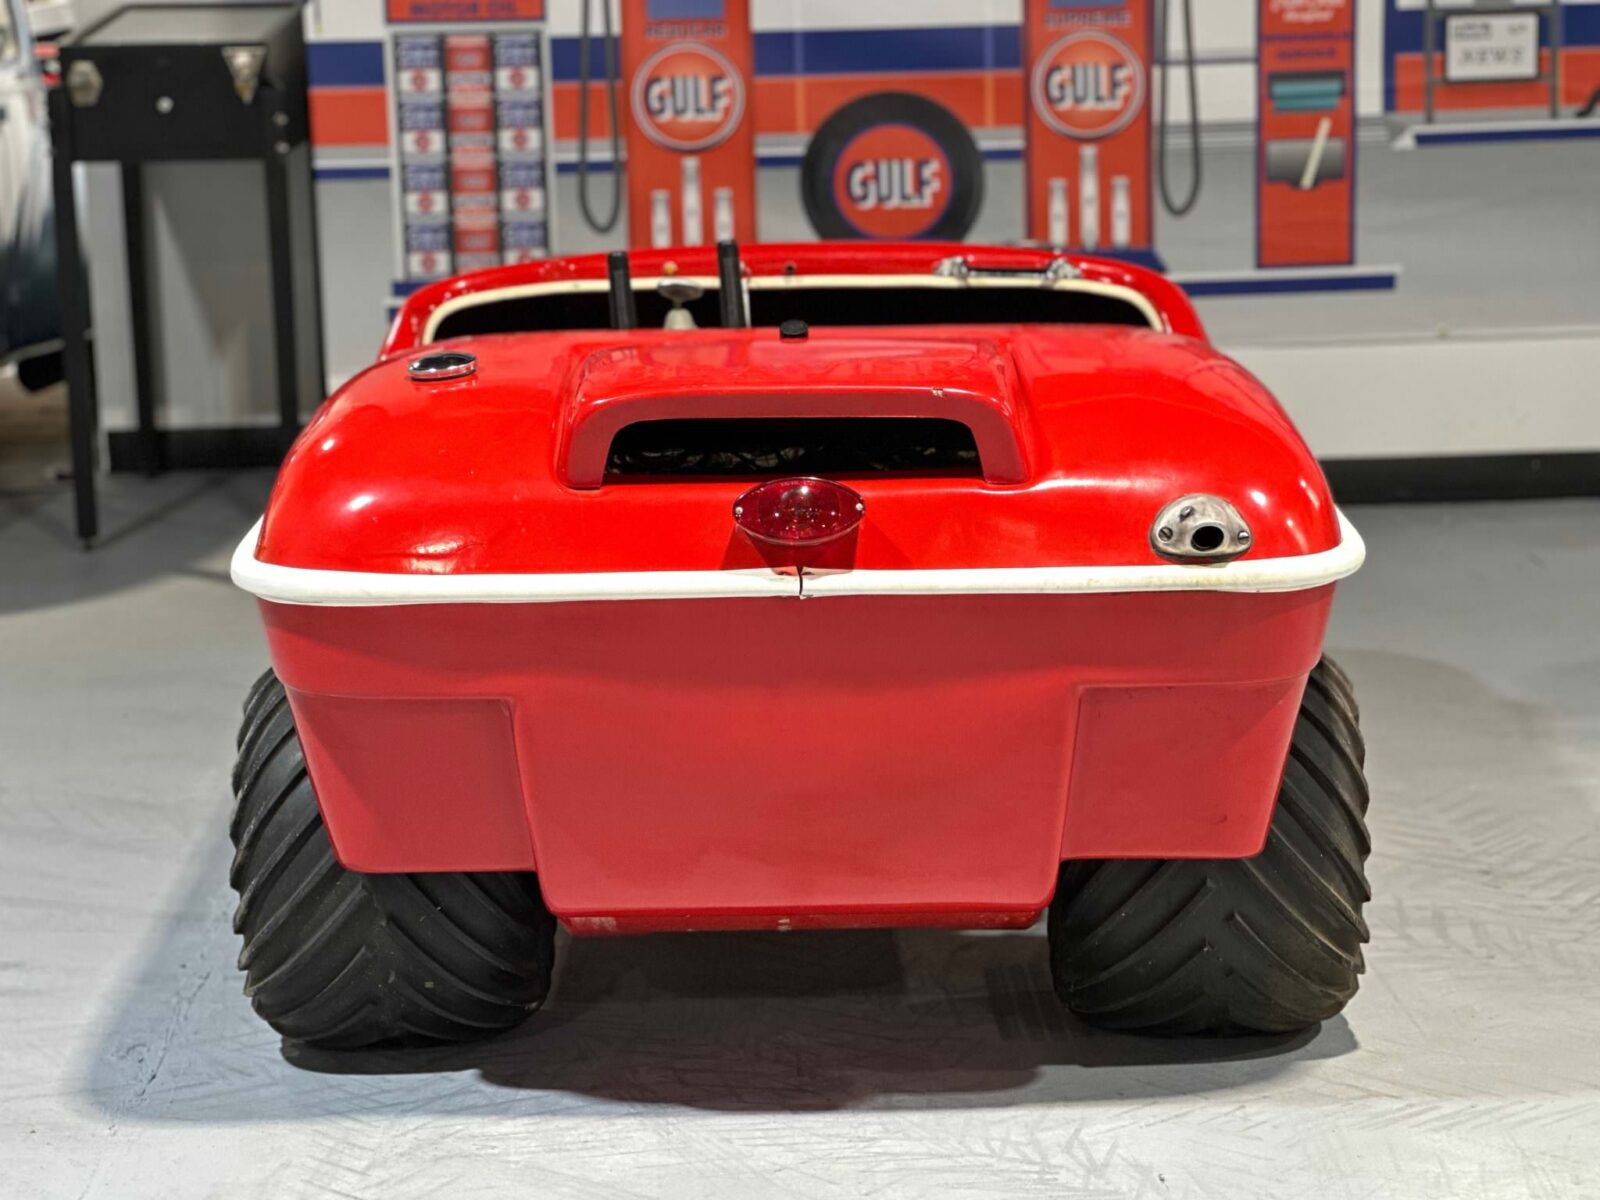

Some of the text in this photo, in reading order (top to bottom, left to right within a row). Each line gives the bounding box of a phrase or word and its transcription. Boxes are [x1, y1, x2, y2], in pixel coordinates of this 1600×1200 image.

[645, 76, 734, 122] GULF
[1046, 63, 1133, 110] GULF
[847, 158, 941, 211] GULF
